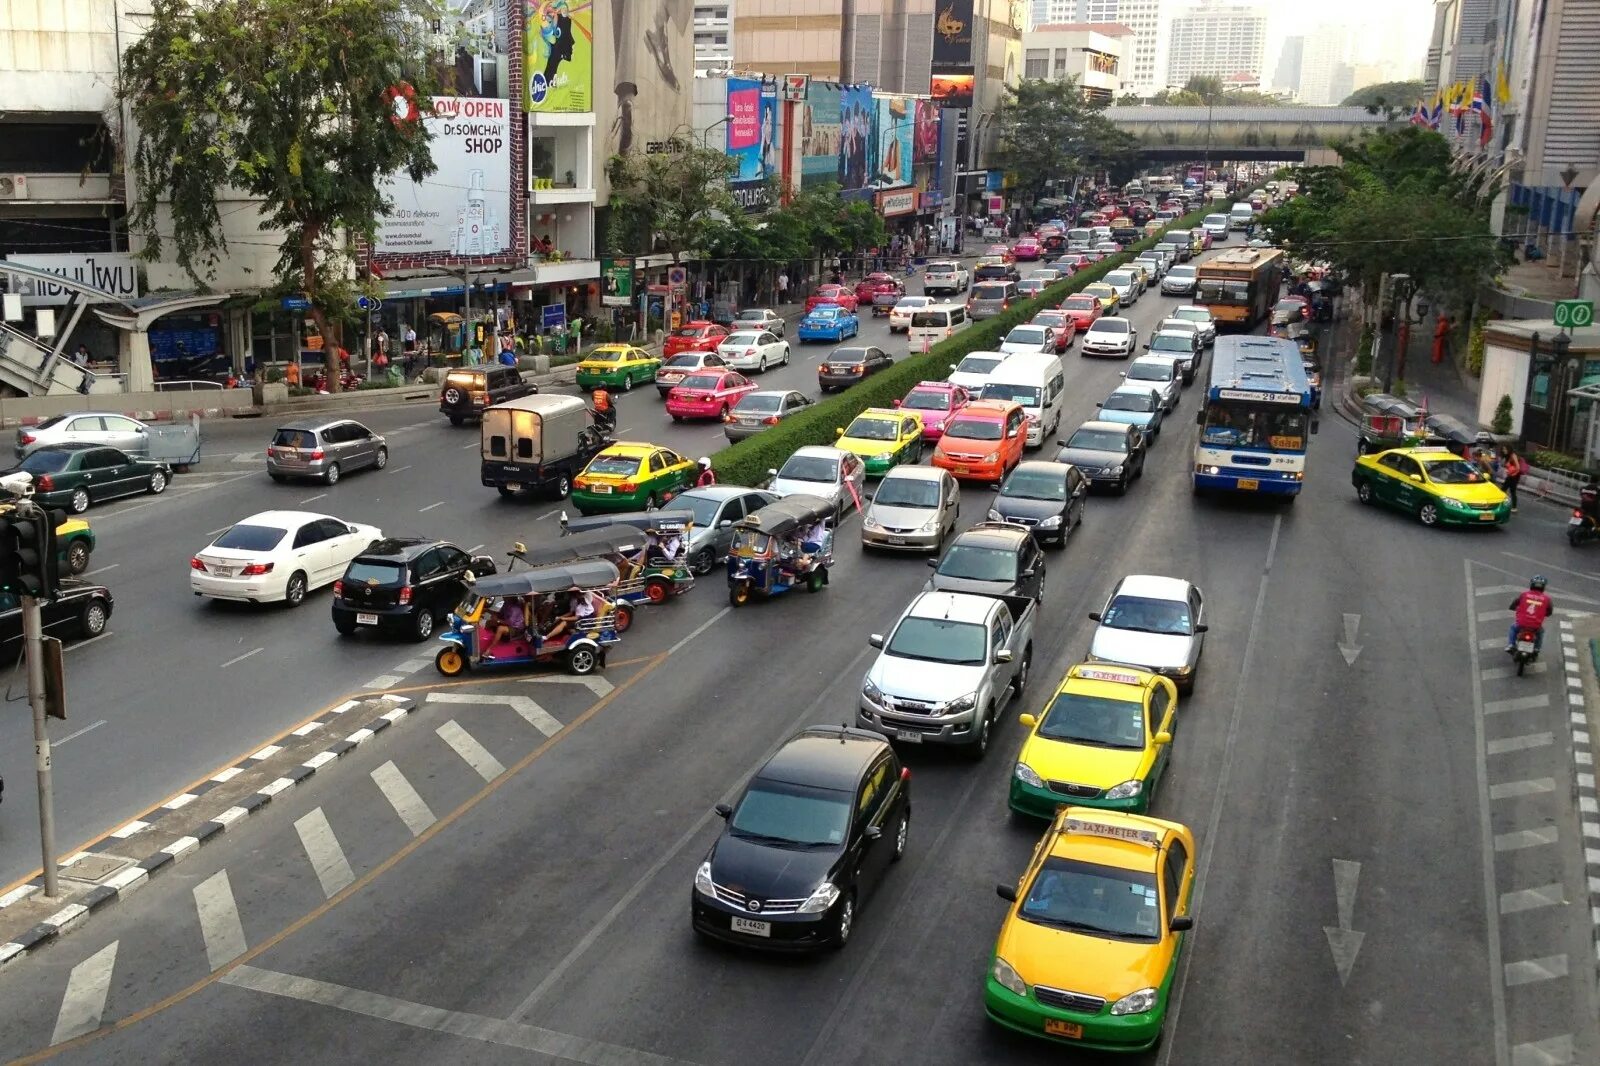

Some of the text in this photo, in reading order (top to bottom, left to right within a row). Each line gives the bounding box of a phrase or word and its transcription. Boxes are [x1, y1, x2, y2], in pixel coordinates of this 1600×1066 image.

[430, 101, 503, 118] OW OPEN
[465, 138, 502, 153] SHOP
[1262, 393, 1275, 401] 29
[1092, 671, 1136, 683] TAXI-METER
[1082, 822, 1138, 839] TAXI-METER
